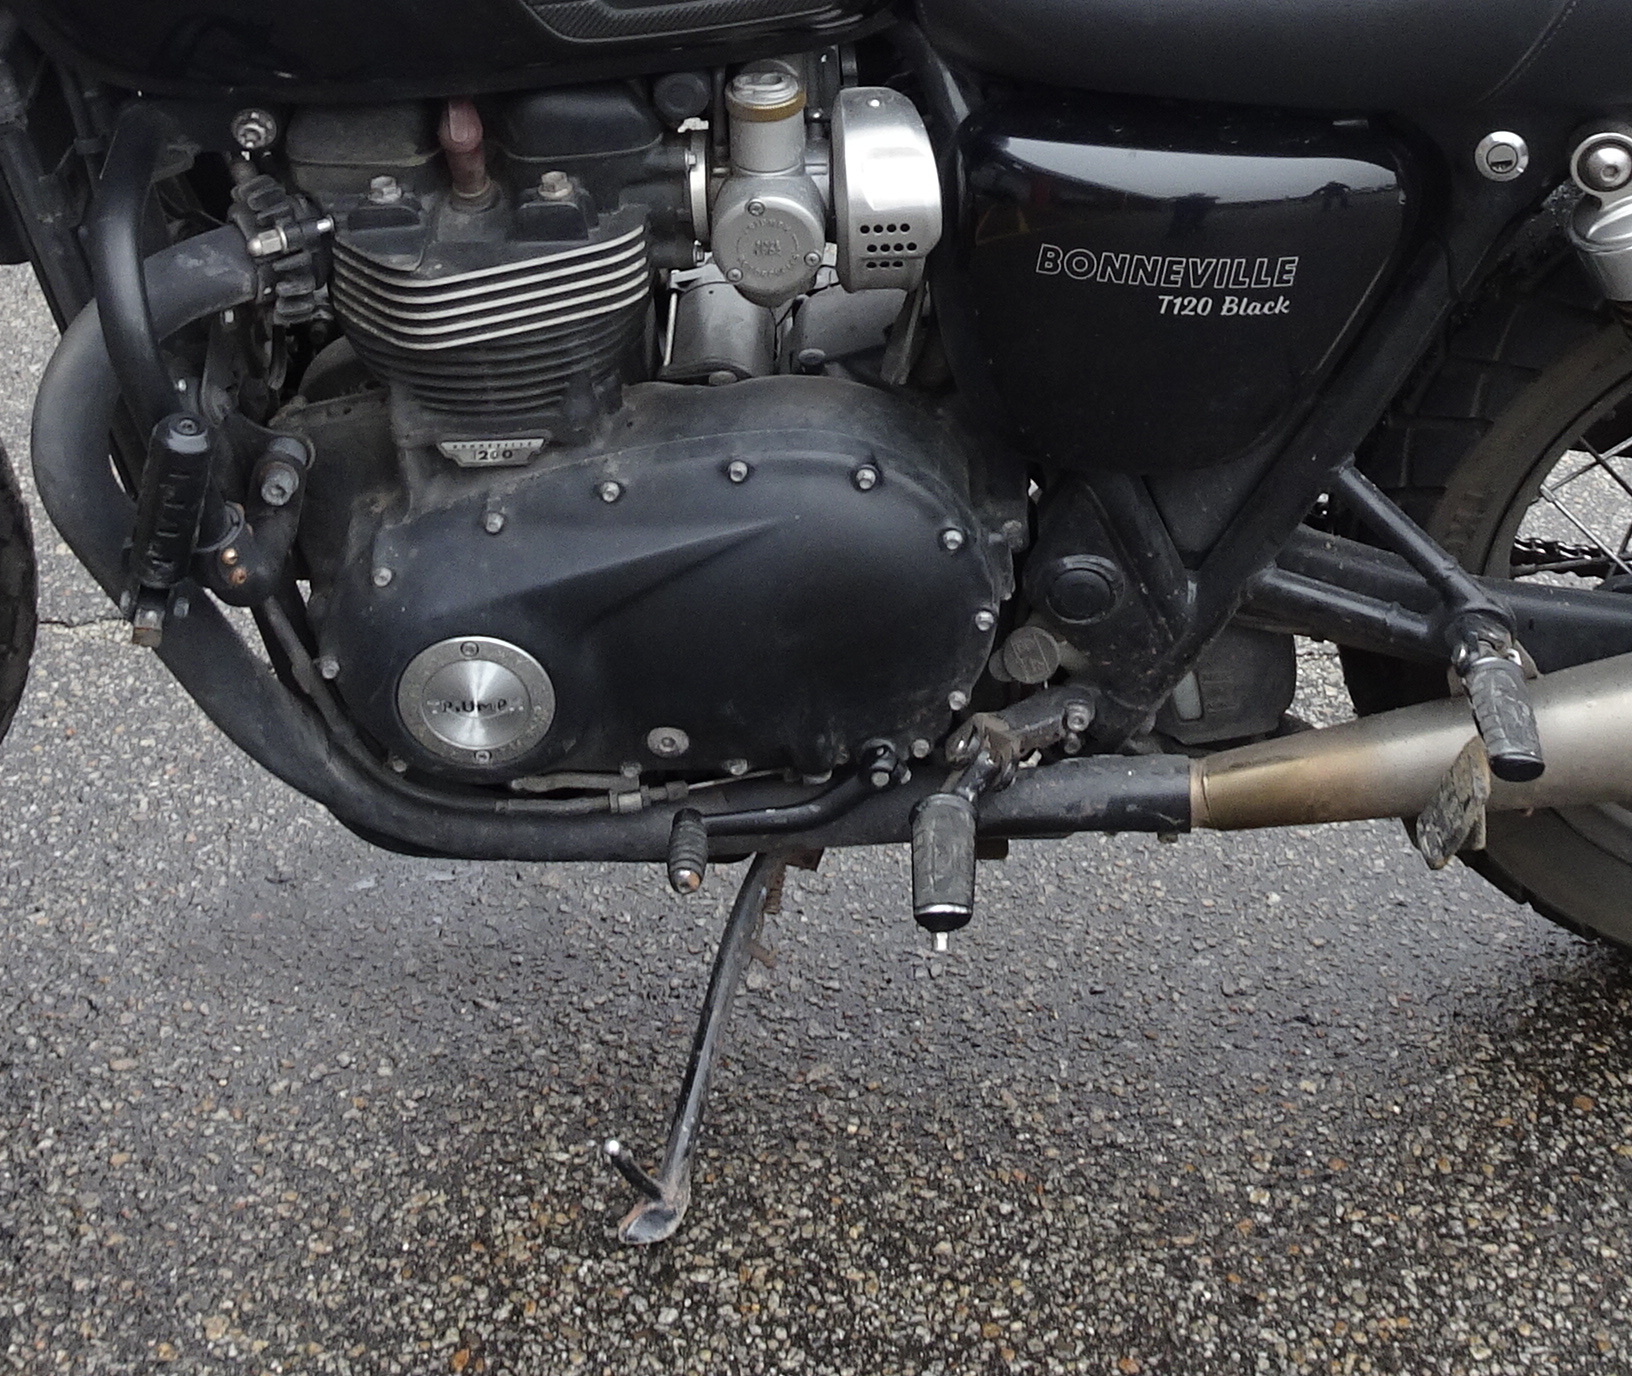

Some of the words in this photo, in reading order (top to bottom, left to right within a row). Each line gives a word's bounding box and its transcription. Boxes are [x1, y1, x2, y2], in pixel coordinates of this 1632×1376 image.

[1035, 243, 1299, 289] BONNEVILLE
[1157, 294, 1213, 316] T120
[1220, 294, 1291, 317] Black
